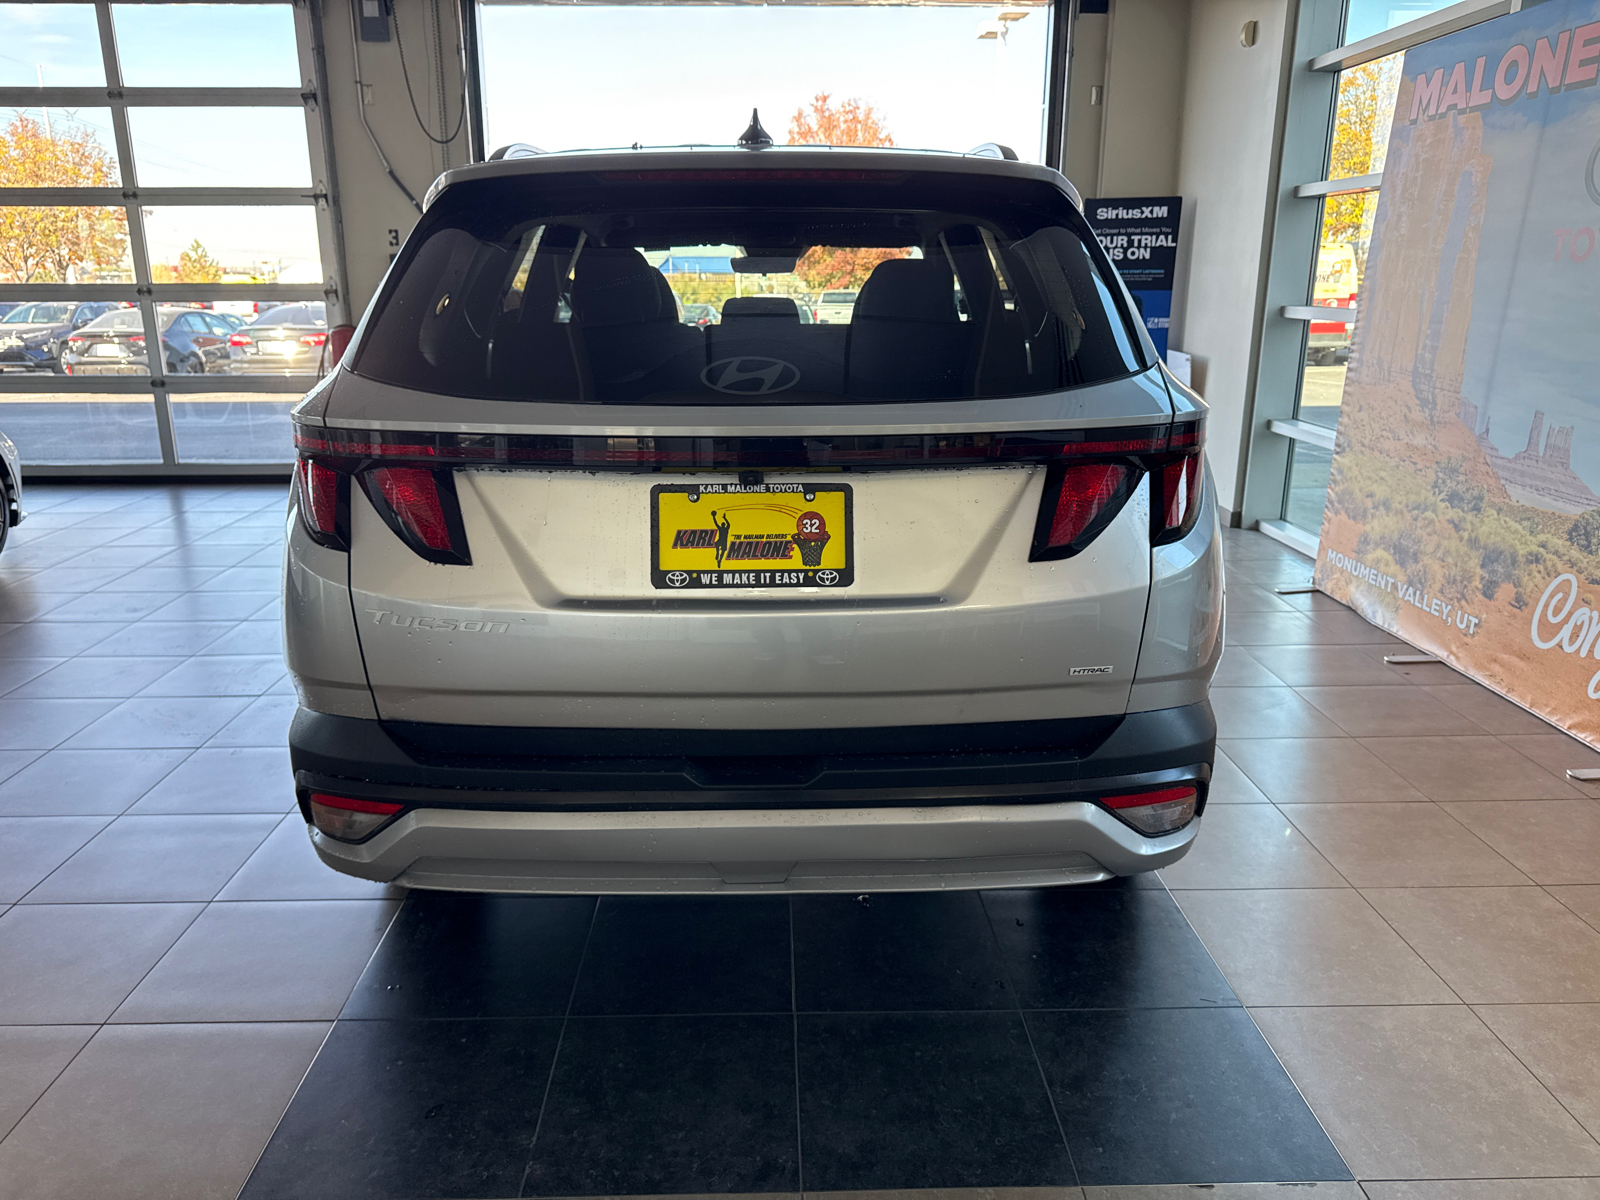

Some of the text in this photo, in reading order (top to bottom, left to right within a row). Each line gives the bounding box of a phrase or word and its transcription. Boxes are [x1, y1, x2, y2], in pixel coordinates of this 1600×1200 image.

[1409, 20, 1600, 126] MALONE
[1096, 206, 1168, 220] SiriusXM
[388, 229, 399, 247] 3
[1098, 235, 1177, 248] OUR TRIAL
[1553, 226, 1600, 263] TO
[1109, 247, 1151, 260] IS ON
[699, 484, 804, 493] KARL MALONE TOYOTA
[802, 519, 820, 533] 32
[672, 529, 718, 549] KARL
[726, 540, 794, 560] MALONE
[700, 572, 805, 585] WE MAKE IT EASY
[1326, 548, 1479, 635] MONUMENT VALLEY, UT
[1072, 667, 1110, 675] HTRAC
